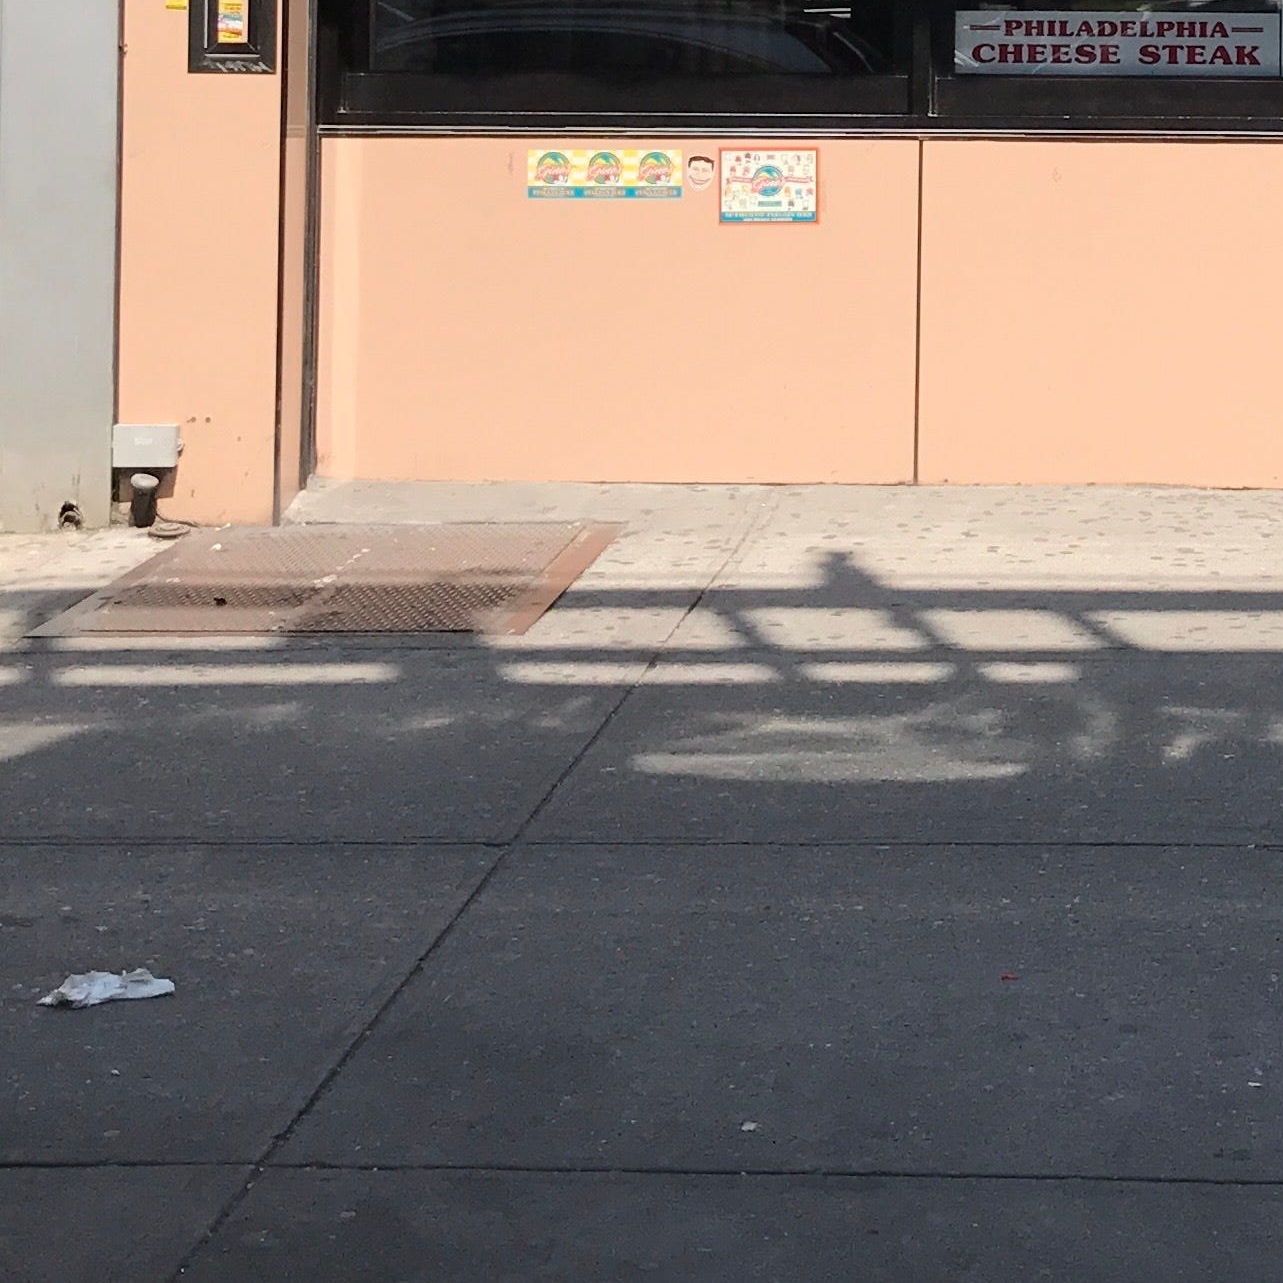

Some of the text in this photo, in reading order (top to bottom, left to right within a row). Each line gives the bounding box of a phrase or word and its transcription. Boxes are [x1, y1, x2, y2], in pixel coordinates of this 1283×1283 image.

[1004, 18, 1229, 41] PHILADELPHIA
[970, 43, 1262, 68] CHEESE STEAK
